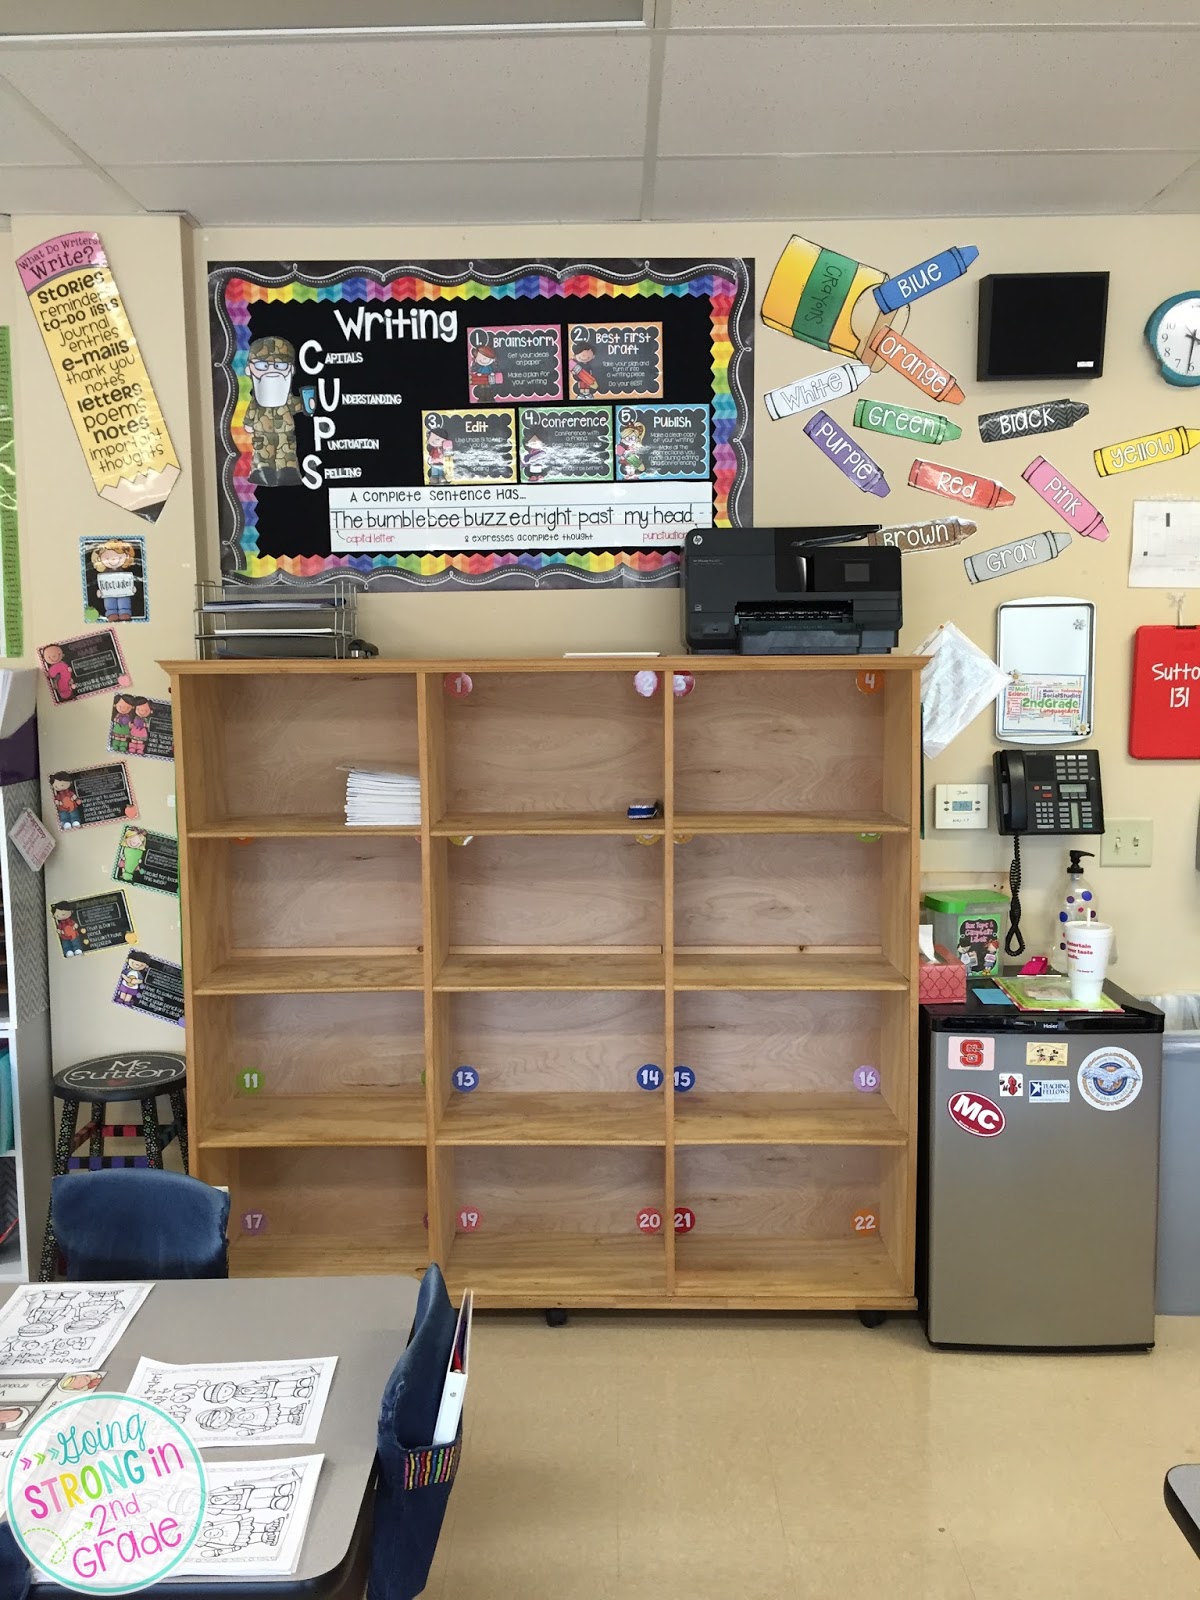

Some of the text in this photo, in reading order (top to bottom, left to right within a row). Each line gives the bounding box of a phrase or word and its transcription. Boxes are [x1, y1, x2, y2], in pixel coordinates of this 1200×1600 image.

[19, 250, 45, 270] What
[45, 245, 60, 255] Do
[30, 245, 94, 280] Write?
[898, 262, 942, 298] Blue
[40, 286, 110, 320] reminder
[90, 298, 119, 317] lists
[60, 315, 110, 347] journal
[333, 306, 457, 342] Writing
[69, 326, 119, 352] entries
[493, 336, 555, 348] Brainstorm
[574, 328, 651, 344] 2. Best First
[1162, 333, 1168, 342] 9
[62, 340, 129, 371] e-mails
[608, 344, 639, 355] Draft
[1164, 347, 1170, 357] 8
[66, 353, 135, 385] thank you
[880, 336, 948, 394] Orange
[1175, 359, 1181, 368] 7
[85, 373, 125, 395] notes
[780, 370, 843, 412] White
[83, 397, 147, 432] poems
[525, 412, 606, 428] 4. Conference
[621, 410, 634, 422] 5.
[867, 406, 935, 437] Green
[93, 415, 150, 444] notes
[428, 415, 488, 433] 3. Edit
[89, 427, 163, 460] important
[937, 472, 977, 499] Red
[350, 491, 358, 503] A
[363, 490, 422, 503] complete
[429, 488, 491, 501] sentence
[331, 504, 695, 531] The bumblebee buzzed right past my head.
[346, 533, 372, 546] capital
[373, 532, 395, 543] letter
[472, 534, 514, 542] expresses
[562, 532, 593, 541] thought
[642, 530, 688, 543] punctuation
[883, 523, 949, 546] Brown
[986, 540, 1038, 572] Gray
[865, 673, 875, 688] 4
[1152, 663, 1200, 681] Sutto
[455, 677, 462, 693] 1
[673, 675, 686, 691] 3
[1022, 698, 1078, 709] 2ndGrade
[1170, 687, 1189, 708] 131
[108, 1060, 151, 1071] Ms
[69, 1068, 176, 1081] Sutton
[244, 1073, 258, 1088] 11
[456, 1071, 475, 1087] 13
[641, 1069, 659, 1086] 14
[674, 1071, 691, 1087] 15
[859, 1071, 877, 1087] 16
[953, 1095, 999, 1130] MC
[245, 1214, 263, 1229] 17
[461, 1212, 478, 1227] 19
[639, 1213, 660, 1228] 20
[674, 1212, 691, 1228] 21
[854, 1215, 876, 1230] 22
